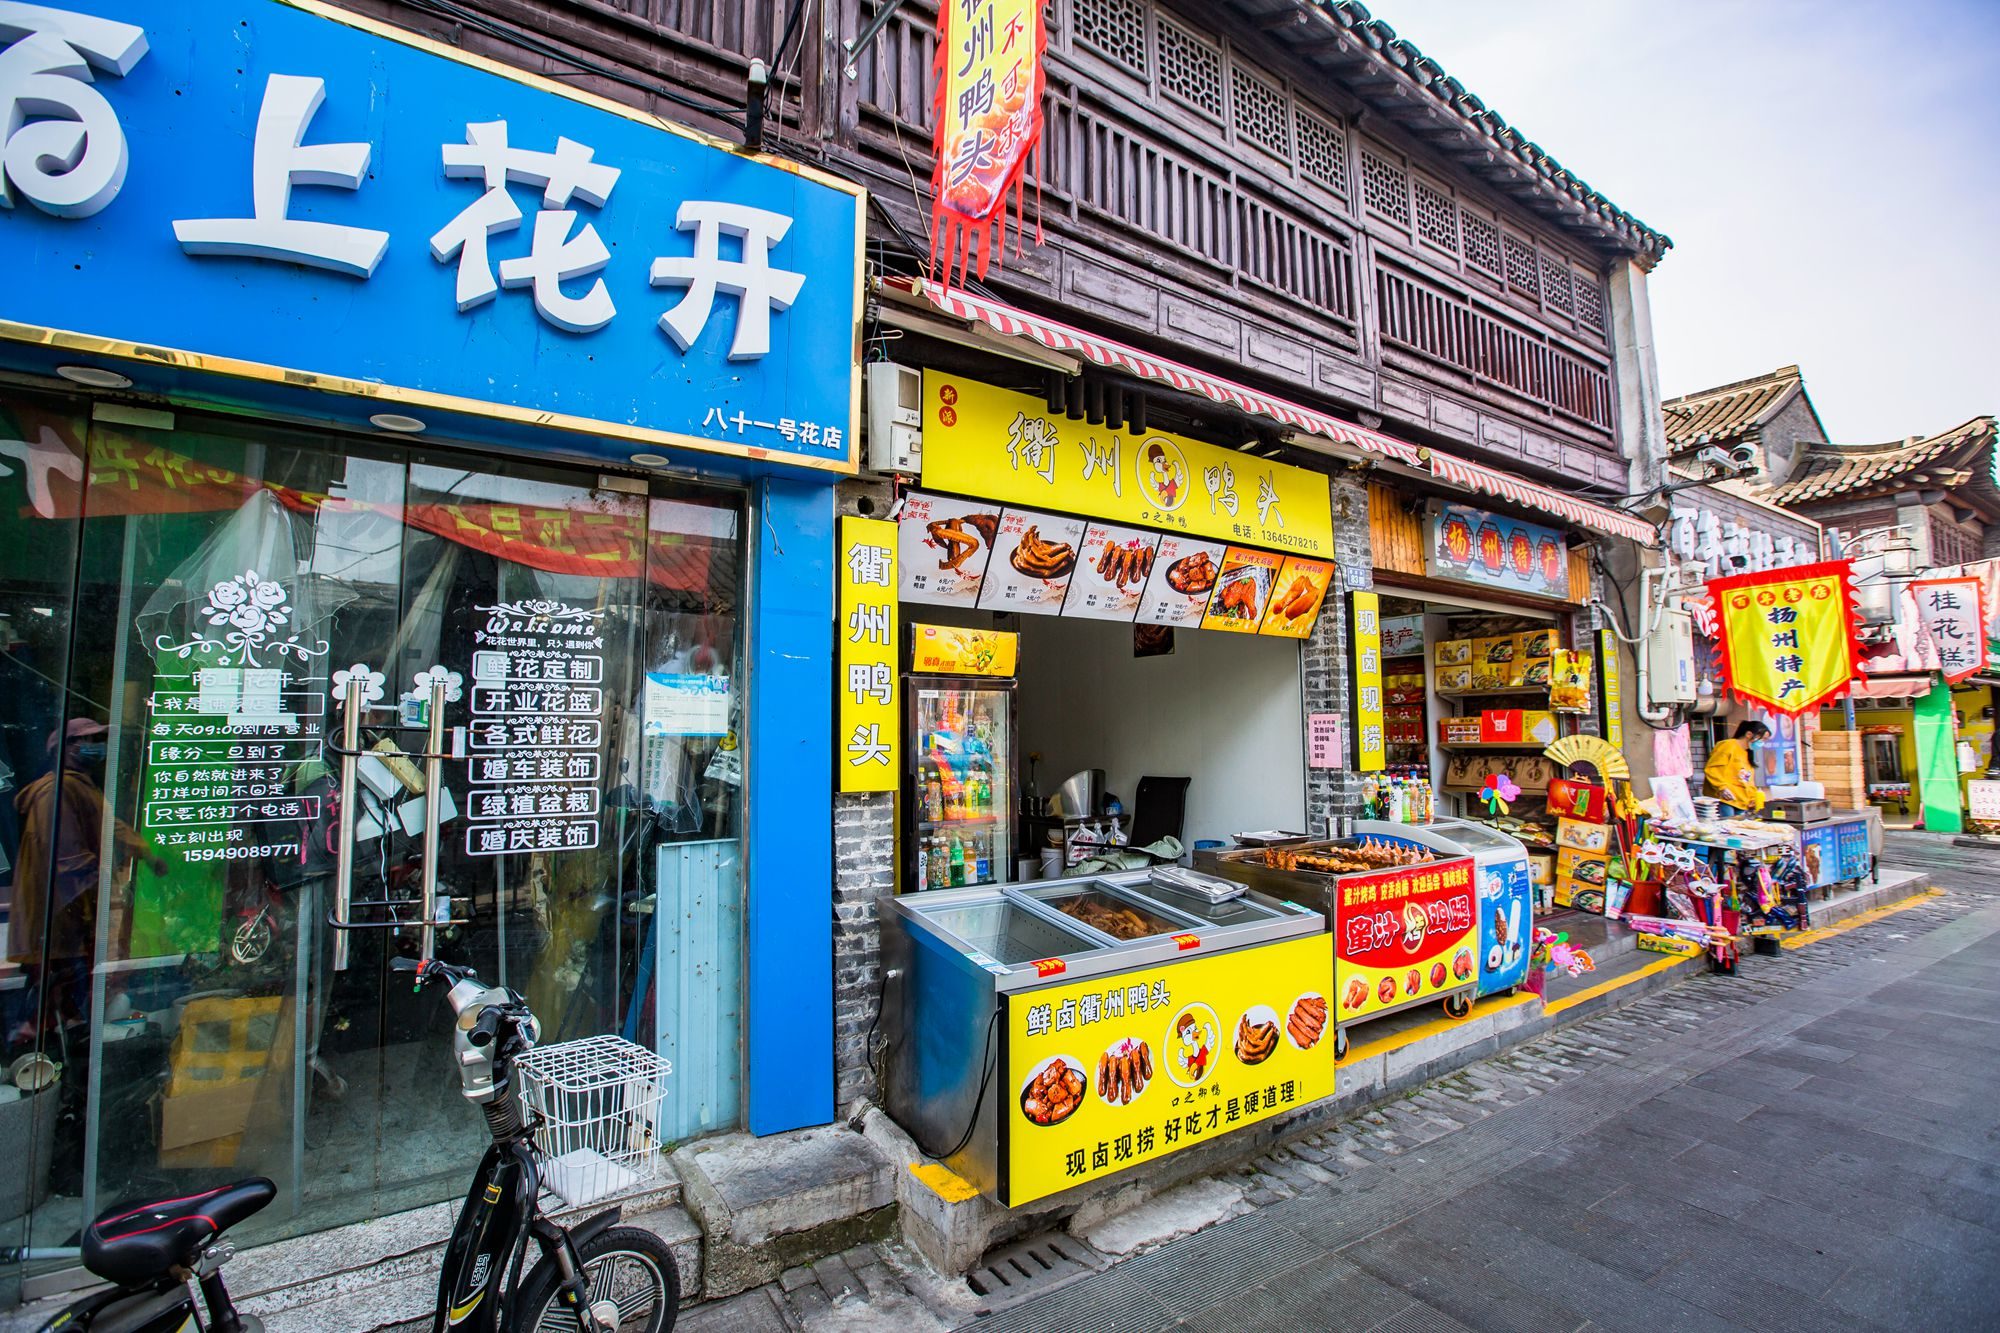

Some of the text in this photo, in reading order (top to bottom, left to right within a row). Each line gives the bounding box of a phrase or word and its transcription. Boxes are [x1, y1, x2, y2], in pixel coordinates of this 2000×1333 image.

[703, 406, 843, 450] 八十一号花店
[1261, 530, 1319, 552] 13645278216
[1449, 525, 1556, 577] 扬州特产
[1734, 585, 1829, 608] 百年老店
[1929, 590, 1965, 667] 桂花糕
[848, 543, 893, 768] 衢州鸭头
[1768, 607, 1806, 698] 扬州特产
[487, 658, 593, 680] 鲜花定制
[1357, 609, 1382, 753] 现卤现捞
[485, 690, 593, 712] 开业花篮
[484, 725, 592, 745] 各式鲜花
[159, 745, 287, 761] 缘分一旦到了
[153, 767, 282, 783] 你自然就进来了
[482, 757, 591, 780] 婚车装饰
[152, 784, 285, 800] 打烊时间不固定
[155, 803, 300, 822] 只要你打个电话
[481, 792, 590, 816] 绿植盆栽
[480, 825, 589, 851] 婚庆装饰
[183, 844, 300, 862] 15949089771
[1026, 979, 1171, 1037] 鲜卤衢州鸭头
[1065, 1079, 1303, 1177] 现卤现捞 好吃才是硬道理！
